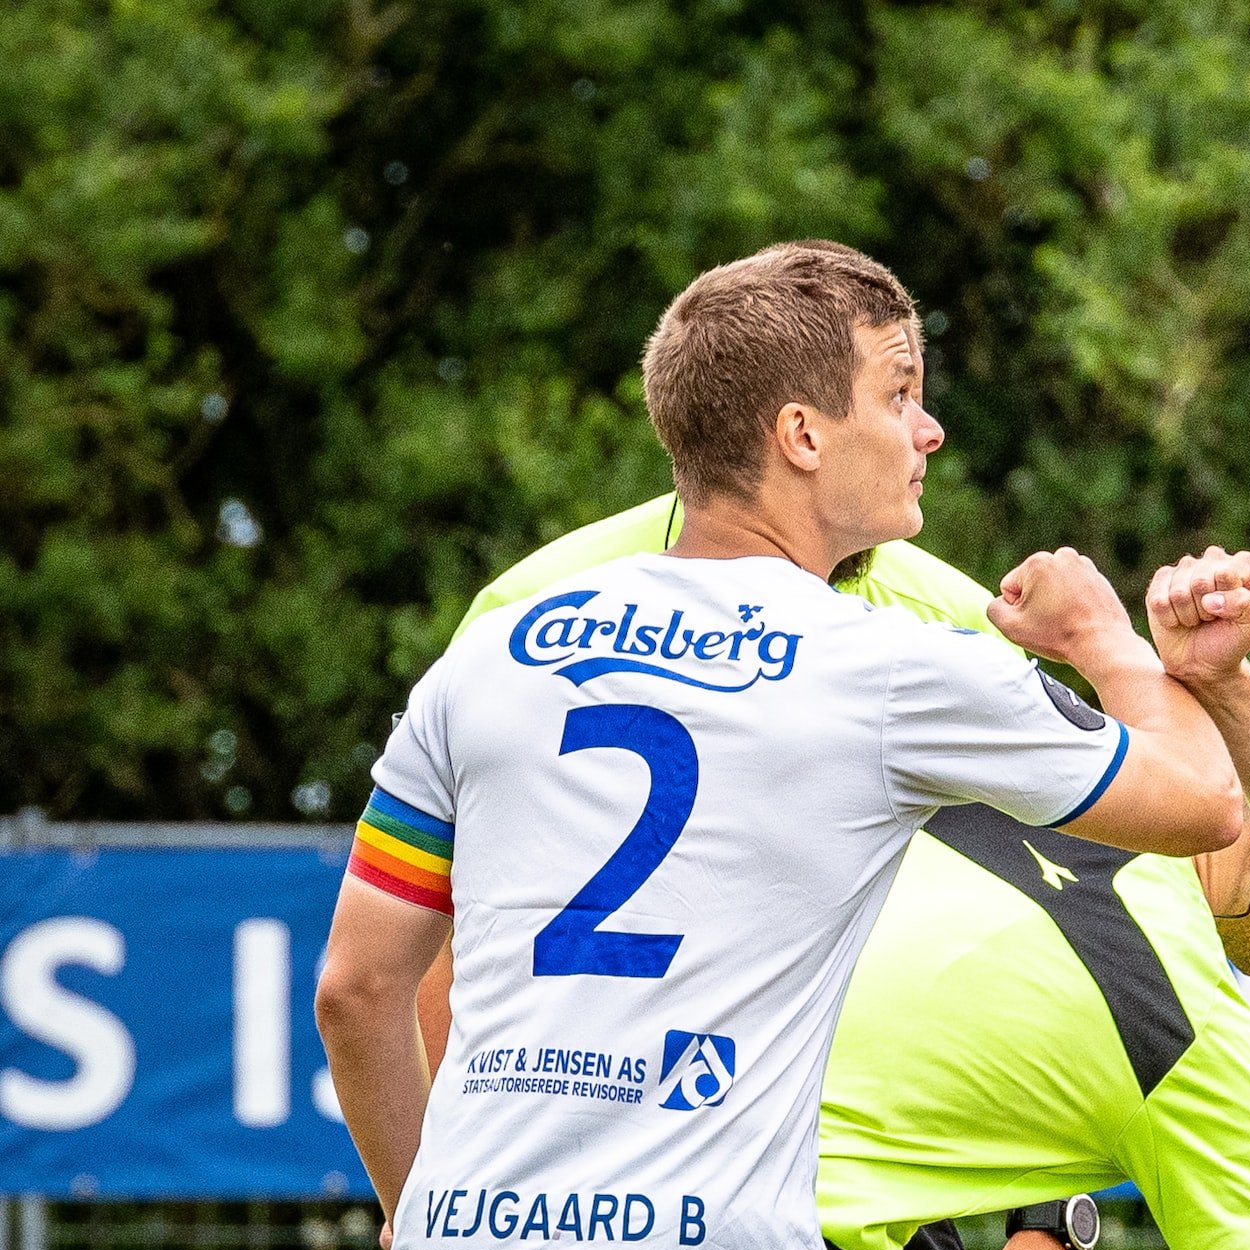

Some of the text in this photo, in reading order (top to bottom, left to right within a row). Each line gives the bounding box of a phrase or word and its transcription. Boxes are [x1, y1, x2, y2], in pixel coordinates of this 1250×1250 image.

[508, 590, 803, 692] Carlsberg
[532, 703, 699, 978] 2
[462, 1076, 644, 1105] STATSAUTORISEREDE REVISORER
[467, 1047, 647, 1084] KVIST & JENSEN AS
[425, 1189, 707, 1246] VEJGAARD B
